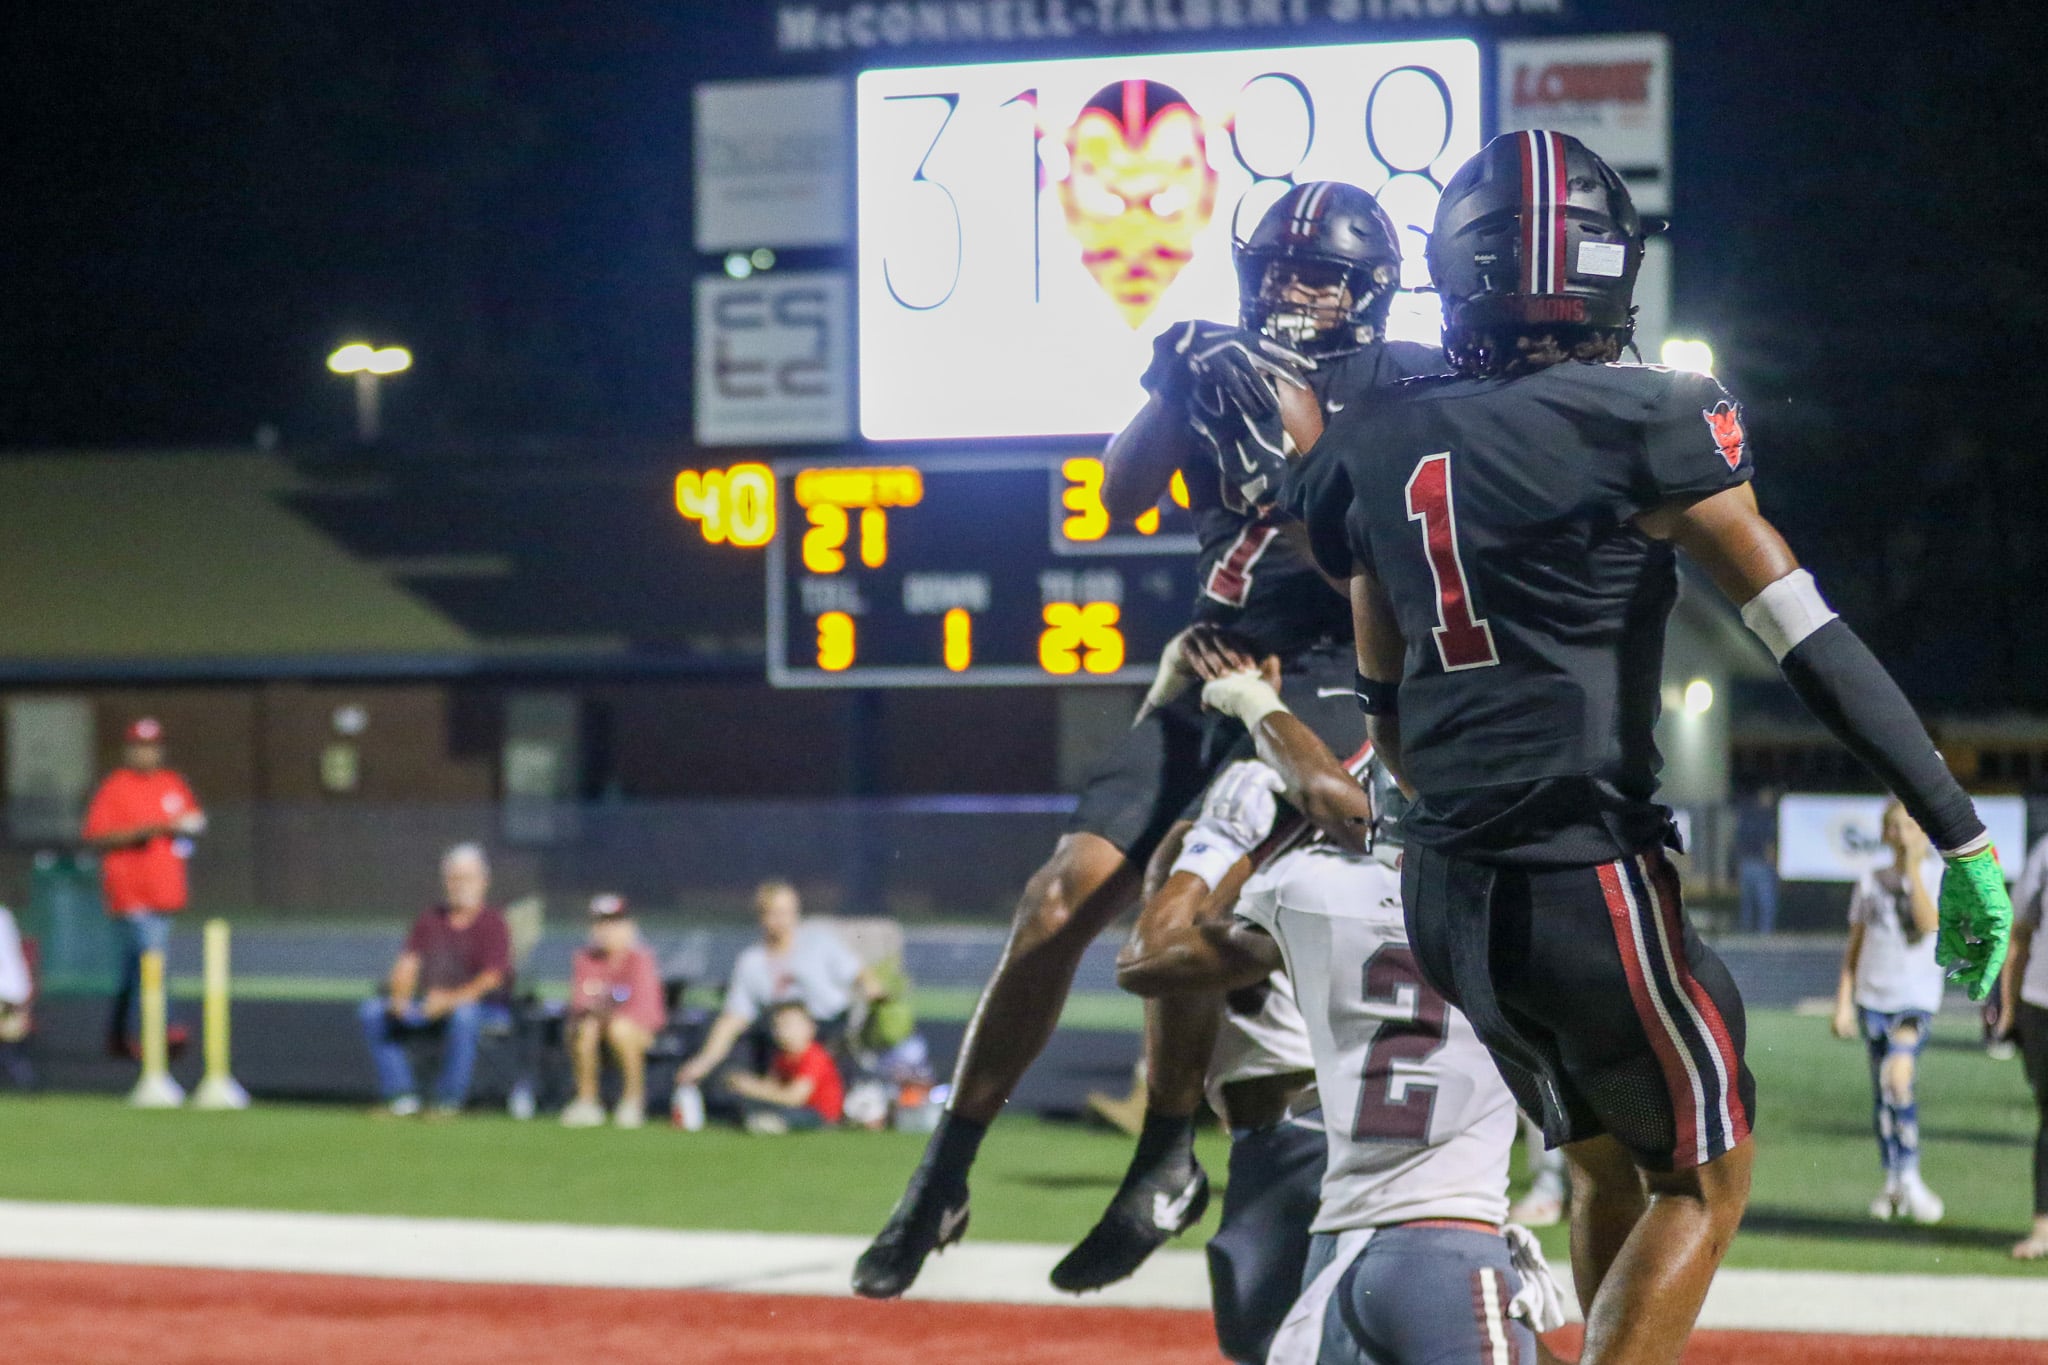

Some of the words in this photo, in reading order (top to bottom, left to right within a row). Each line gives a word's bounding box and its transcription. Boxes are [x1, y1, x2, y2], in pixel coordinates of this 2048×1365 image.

[883, 88, 1040, 311] 31
[675, 462, 777, 547] 40
[1405, 451, 1500, 673] 1
[943, 607, 972, 673] 1
[1038, 601, 1125, 675] 25
[1351, 941, 1451, 1148] 2
